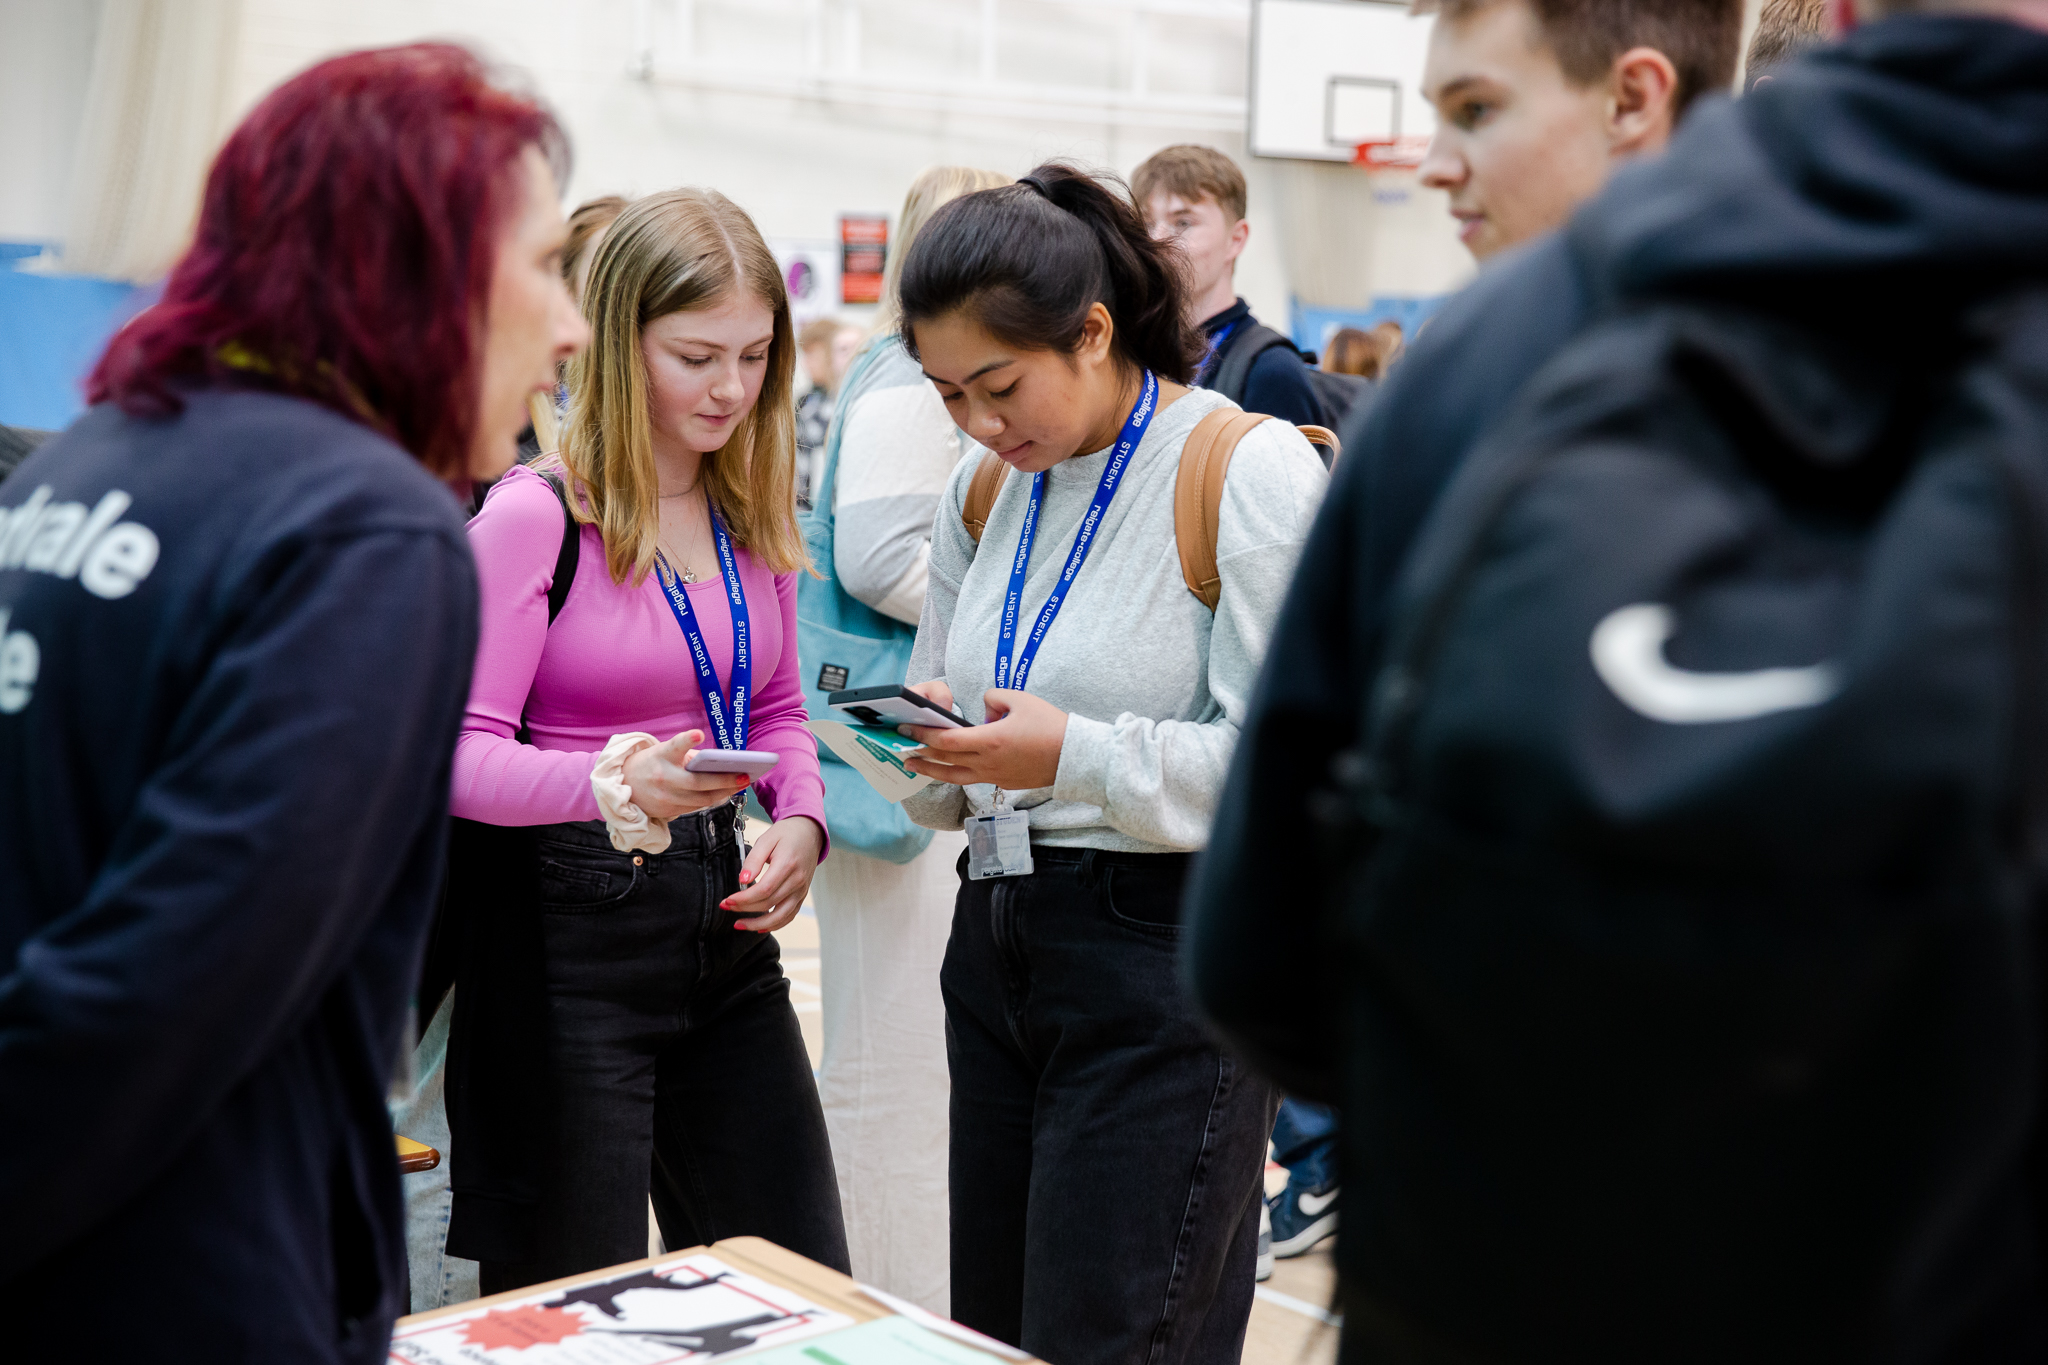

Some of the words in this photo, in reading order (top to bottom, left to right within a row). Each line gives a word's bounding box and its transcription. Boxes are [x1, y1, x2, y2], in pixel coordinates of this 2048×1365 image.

[1103, 441, 1131, 490] STUDENT
[1003, 590, 1018, 639] STUDENT
[1032, 595, 1059, 644] STUDENT
[688, 631, 711, 677] STUDENT
[737, 620, 747, 669] STUDENT
[996, 656, 1009, 689] ollege
[1014, 657, 1029, 691] reigat
[708, 691, 734, 750] gate•college
